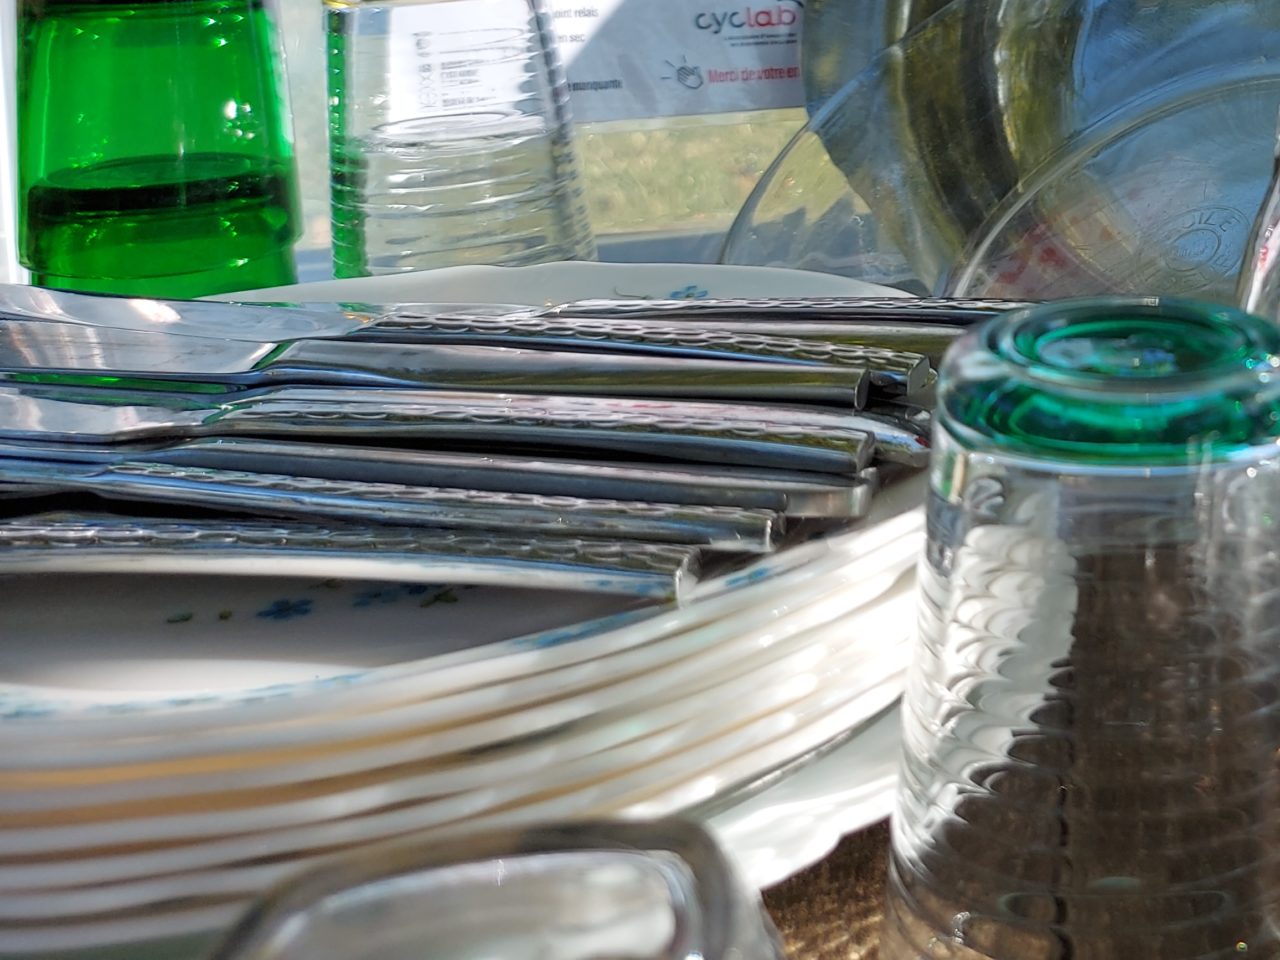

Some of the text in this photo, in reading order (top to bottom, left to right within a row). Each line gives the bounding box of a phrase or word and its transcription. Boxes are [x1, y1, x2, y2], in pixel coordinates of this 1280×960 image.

[574, 6, 600, 18] relais
[694, 5, 796, 34] cyclab
[708, 69, 738, 83] Merci
